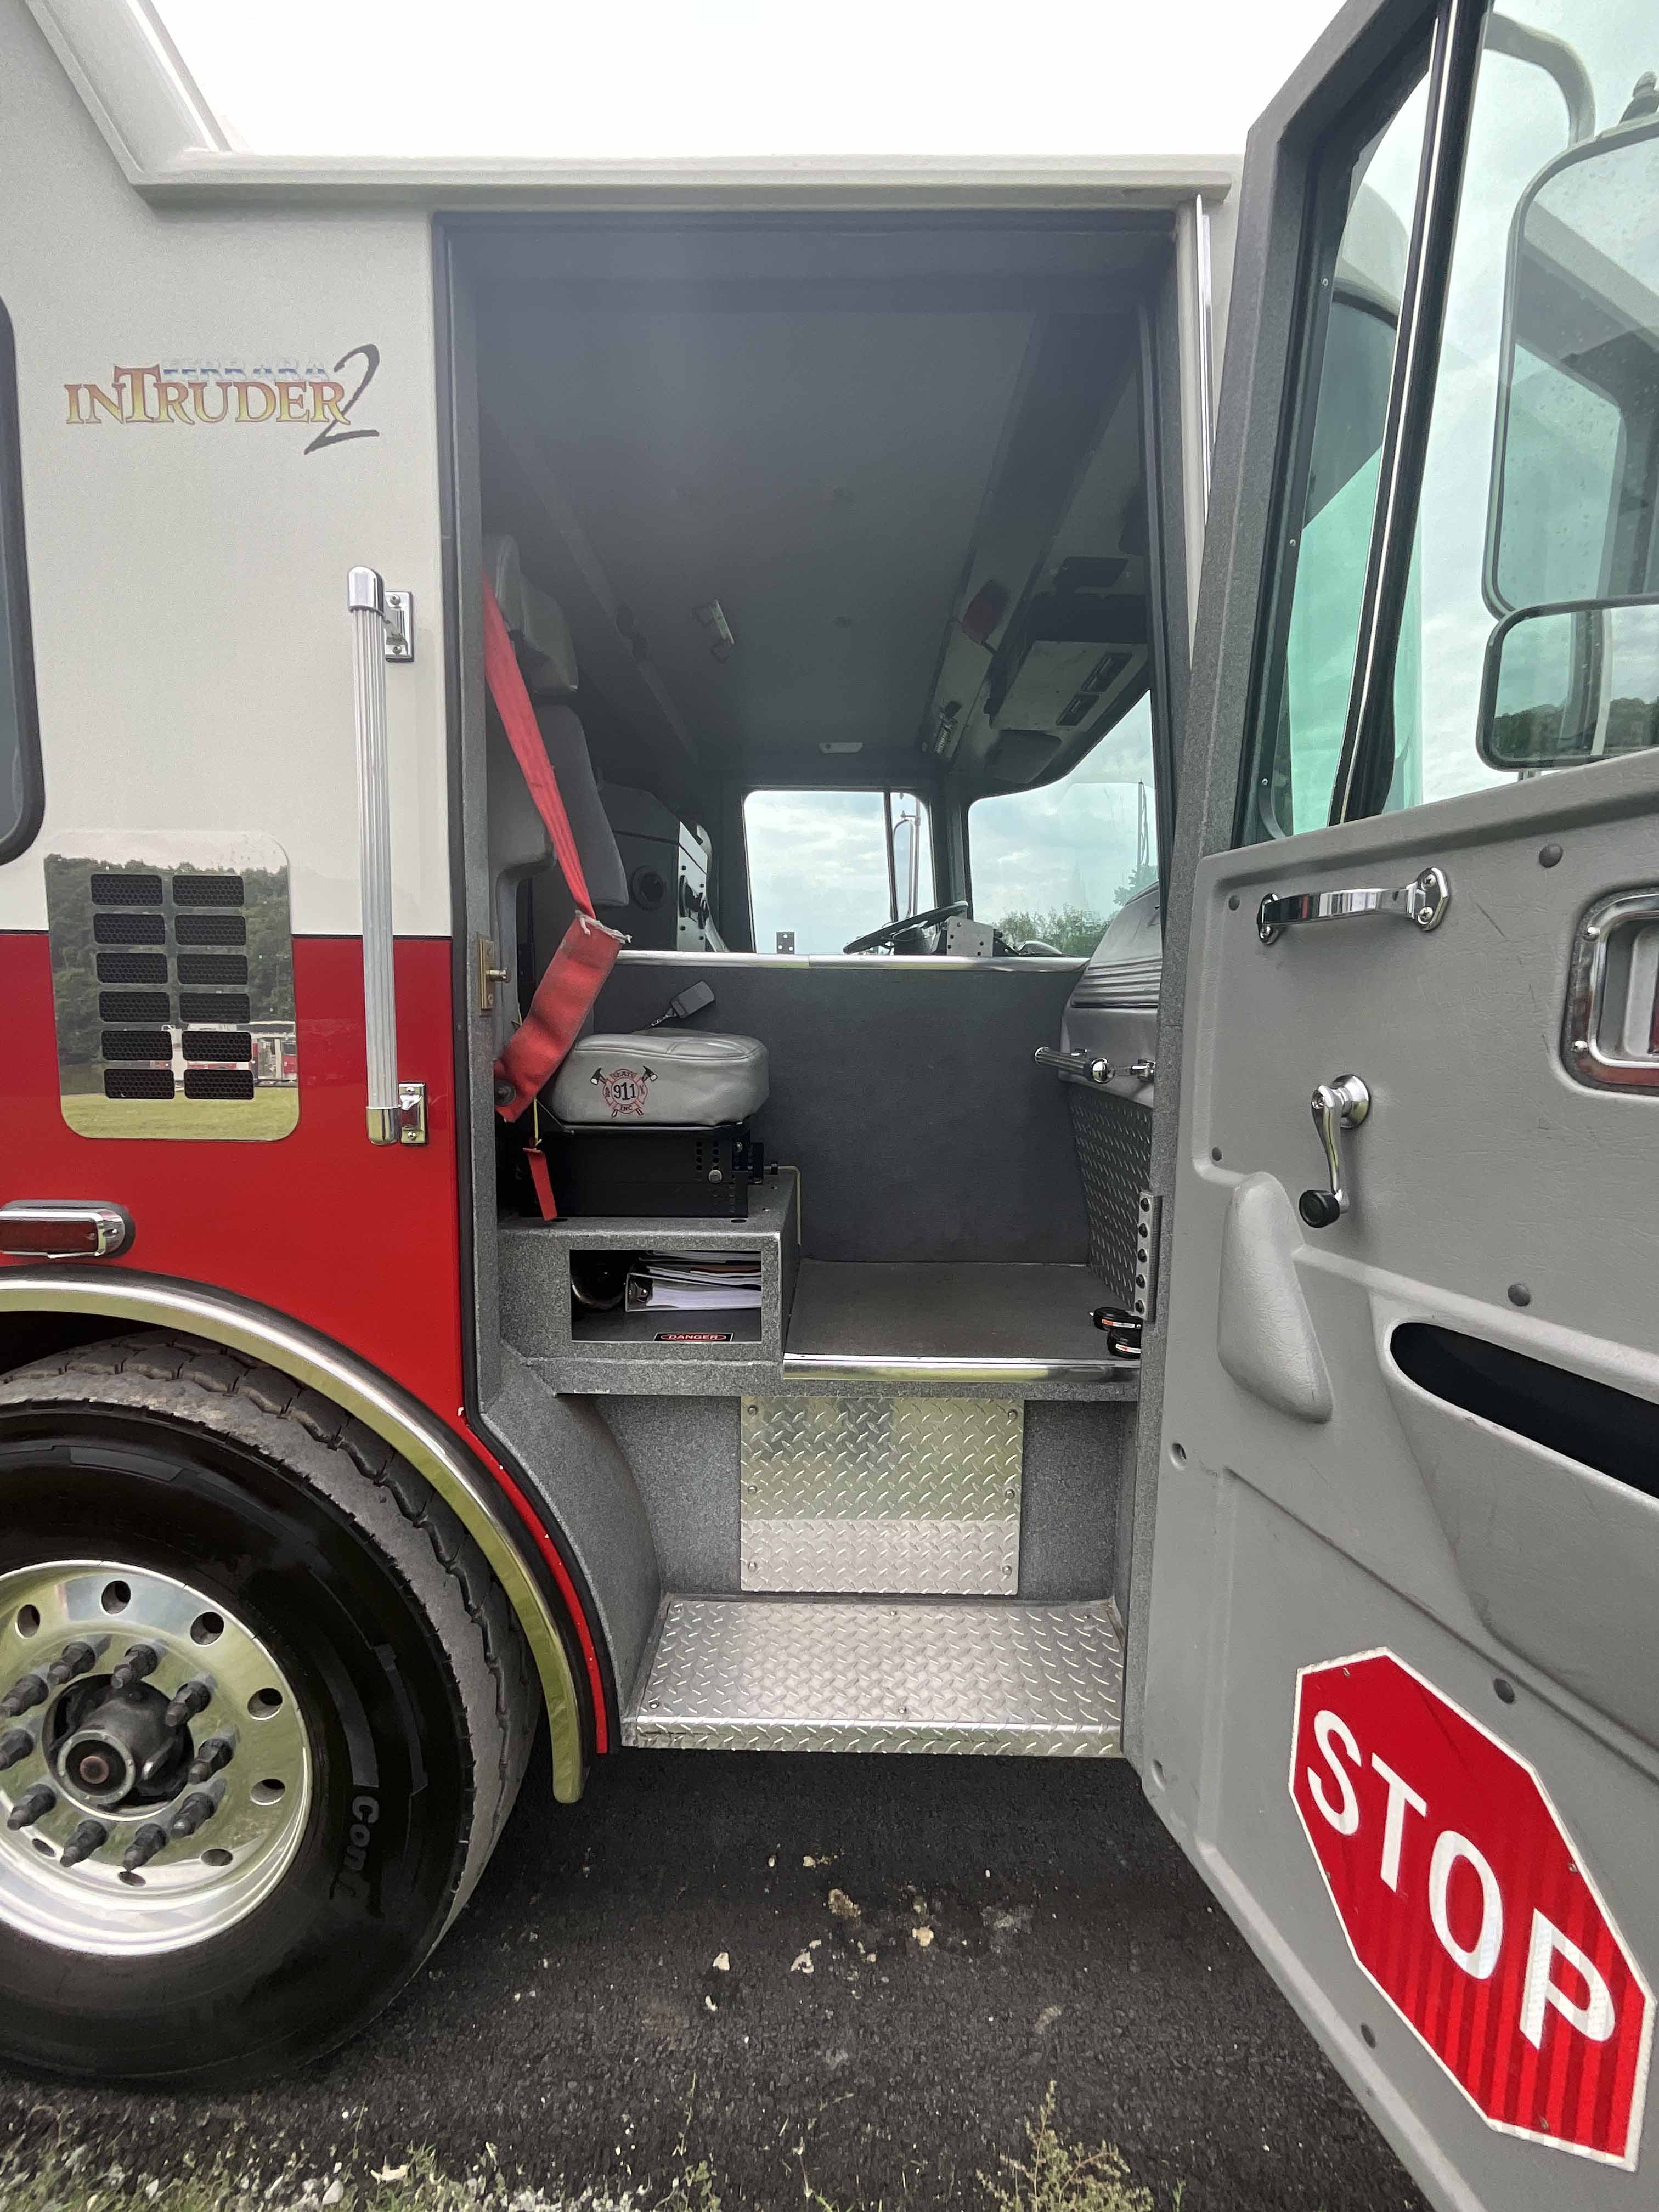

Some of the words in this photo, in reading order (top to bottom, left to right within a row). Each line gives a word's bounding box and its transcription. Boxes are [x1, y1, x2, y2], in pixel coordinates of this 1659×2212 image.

[64, 364, 351, 425] INTRUDER
[304, 343, 381, 455] 2
[613, 1082, 636, 1100] 911
[1306, 1709, 1616, 2050] STOP
